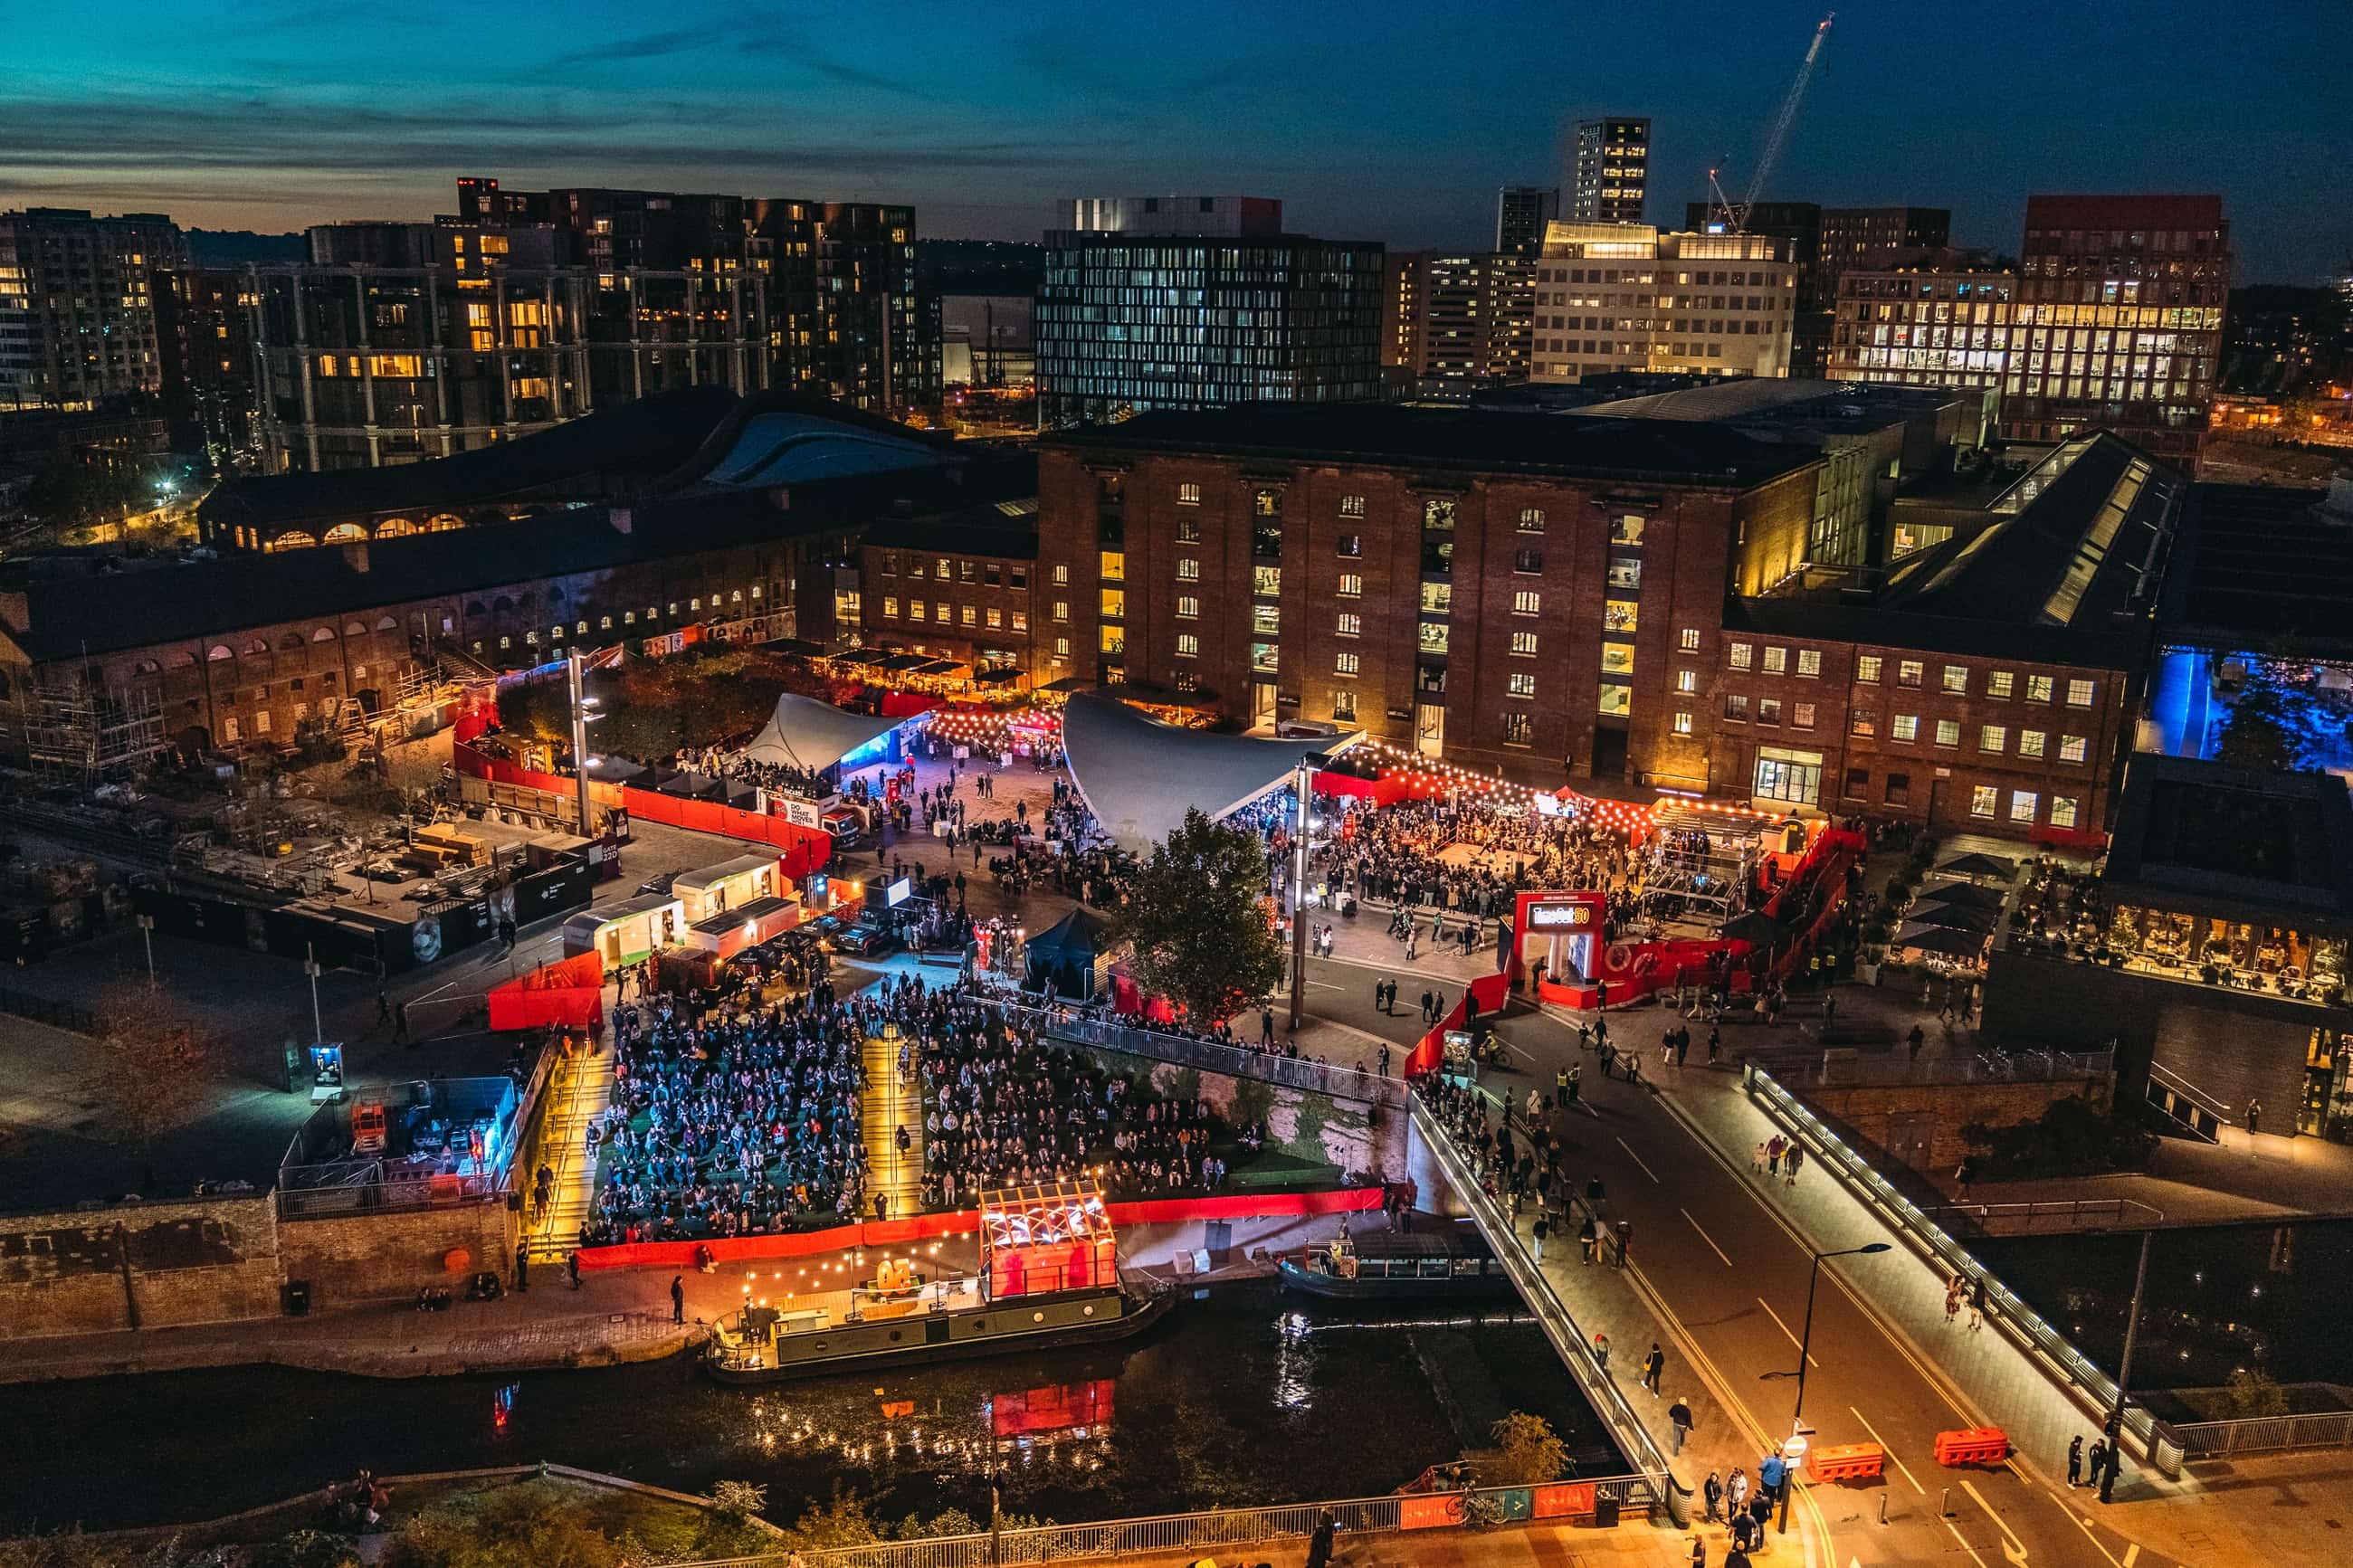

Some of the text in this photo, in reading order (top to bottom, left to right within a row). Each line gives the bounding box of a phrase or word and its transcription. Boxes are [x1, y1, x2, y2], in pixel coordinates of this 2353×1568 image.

[792, 814, 814, 823] MOVES
[603, 844, 617, 853] GATE
[603, 851, 617, 861] 22D
[1575, 908, 1589, 924] 50
